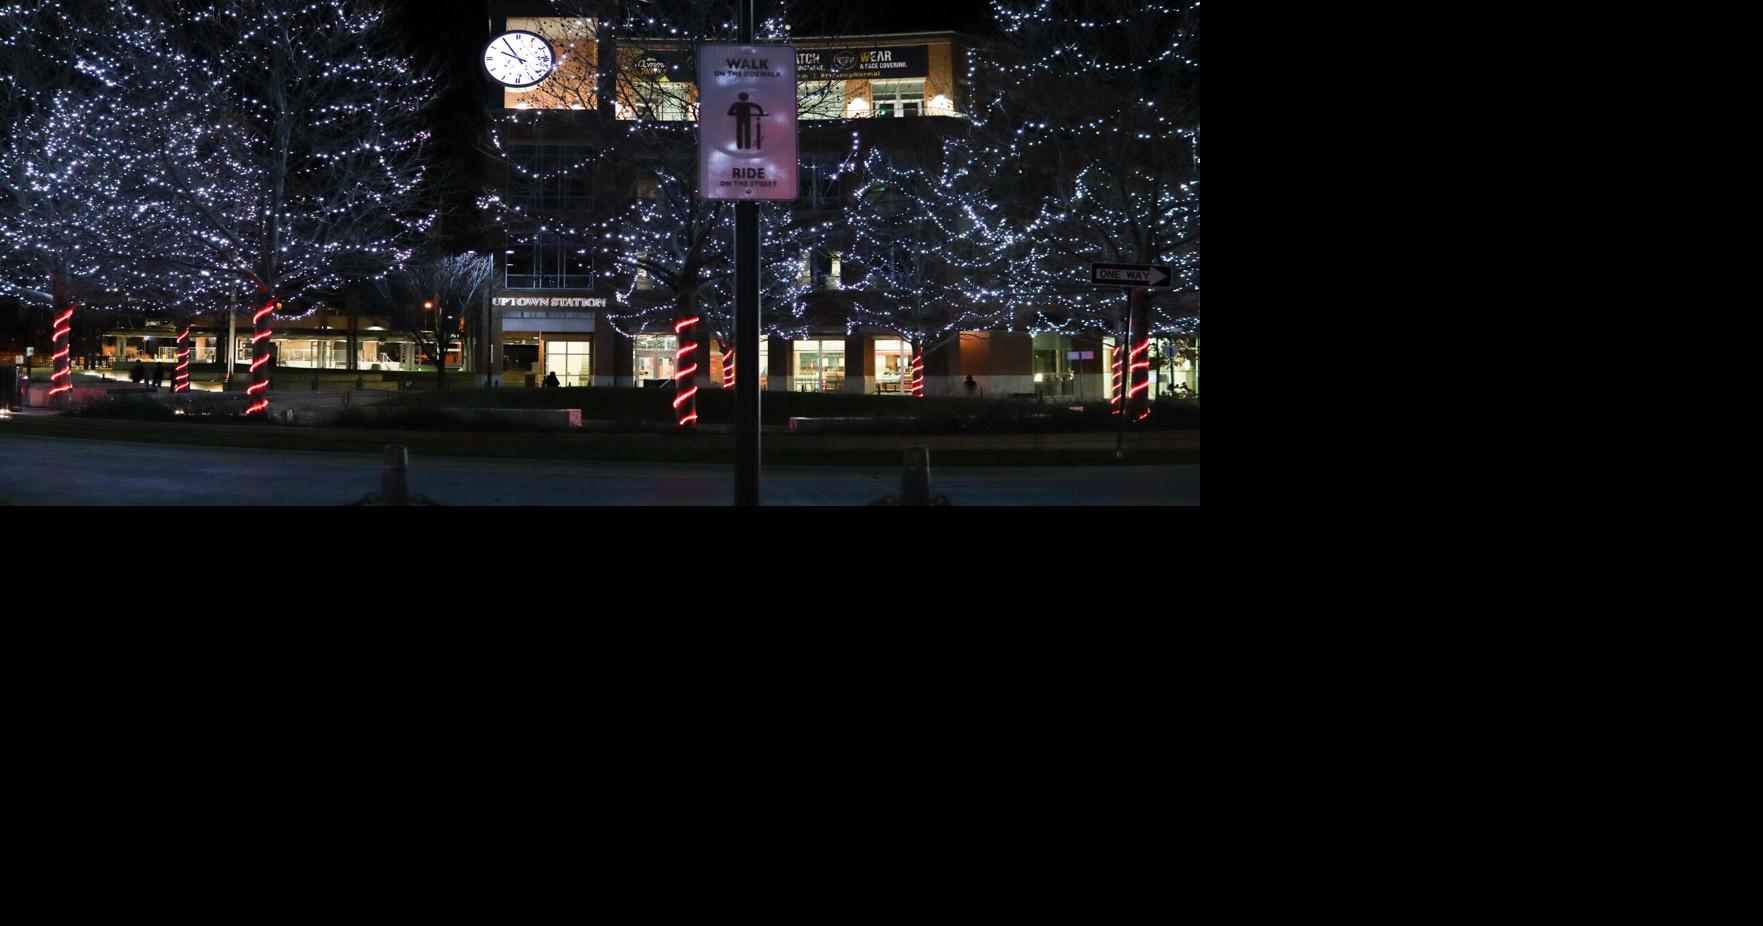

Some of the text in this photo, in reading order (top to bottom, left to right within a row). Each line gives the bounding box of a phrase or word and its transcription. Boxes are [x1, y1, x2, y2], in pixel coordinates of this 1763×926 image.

[796, 53, 820, 64] ATCH
[861, 50, 892, 62] WEAR
[726, 58, 769, 70] WALK
[879, 61, 908, 69] COVERING.
[728, 70, 742, 78] THE
[732, 167, 765, 179] RIDE
[1100, 269, 1150, 281] ONE WAY
[492, 297, 607, 307] UPTOWN STATION
